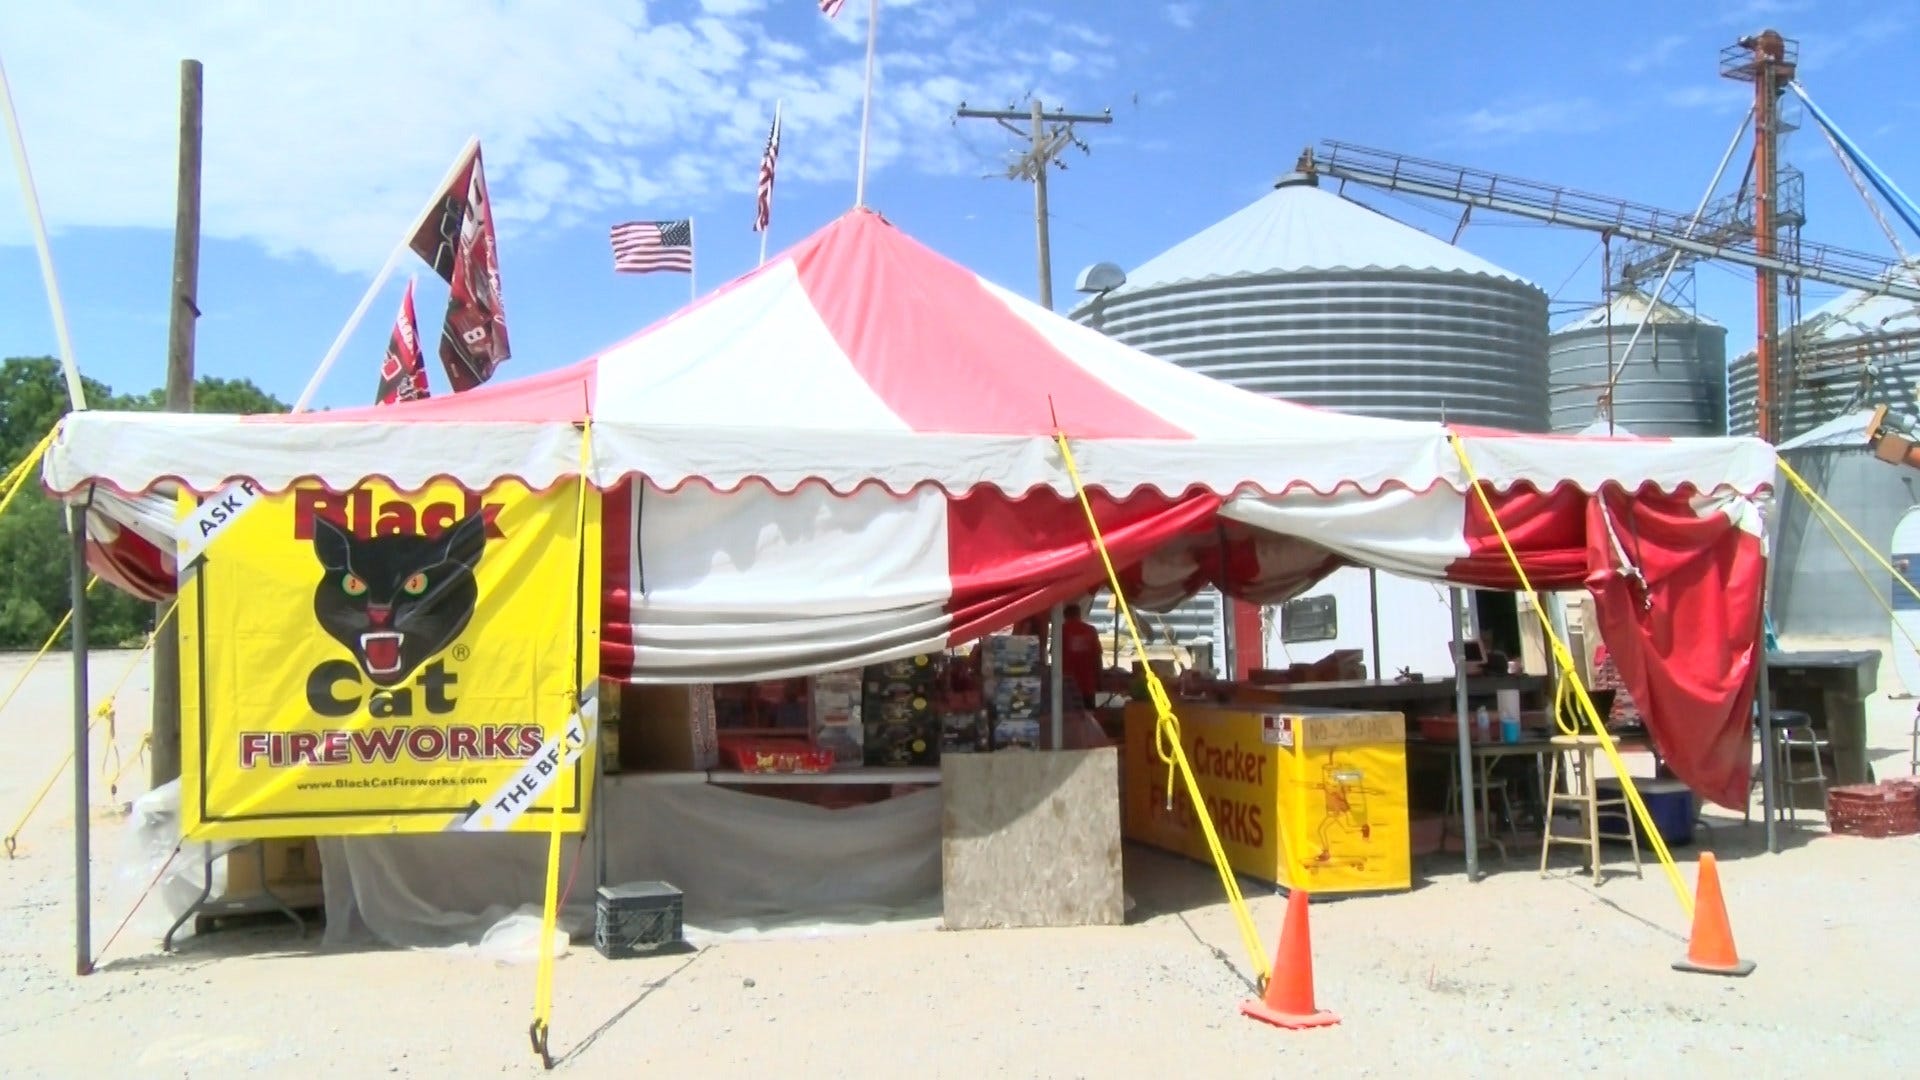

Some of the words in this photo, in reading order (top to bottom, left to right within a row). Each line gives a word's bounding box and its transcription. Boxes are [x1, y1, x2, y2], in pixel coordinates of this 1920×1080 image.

[200, 495, 242, 537] ASK
[295, 488, 506, 541] Black
[306, 658, 458, 718] Cat
[240, 723, 545, 768] FIREWORKS
[1193, 735, 1267, 786] Cracker
[297, 776, 488, 791] www.BlackCatFireworks.com
[495, 774, 538, 813] THE
[1150, 783, 1264, 848] FEORKS
